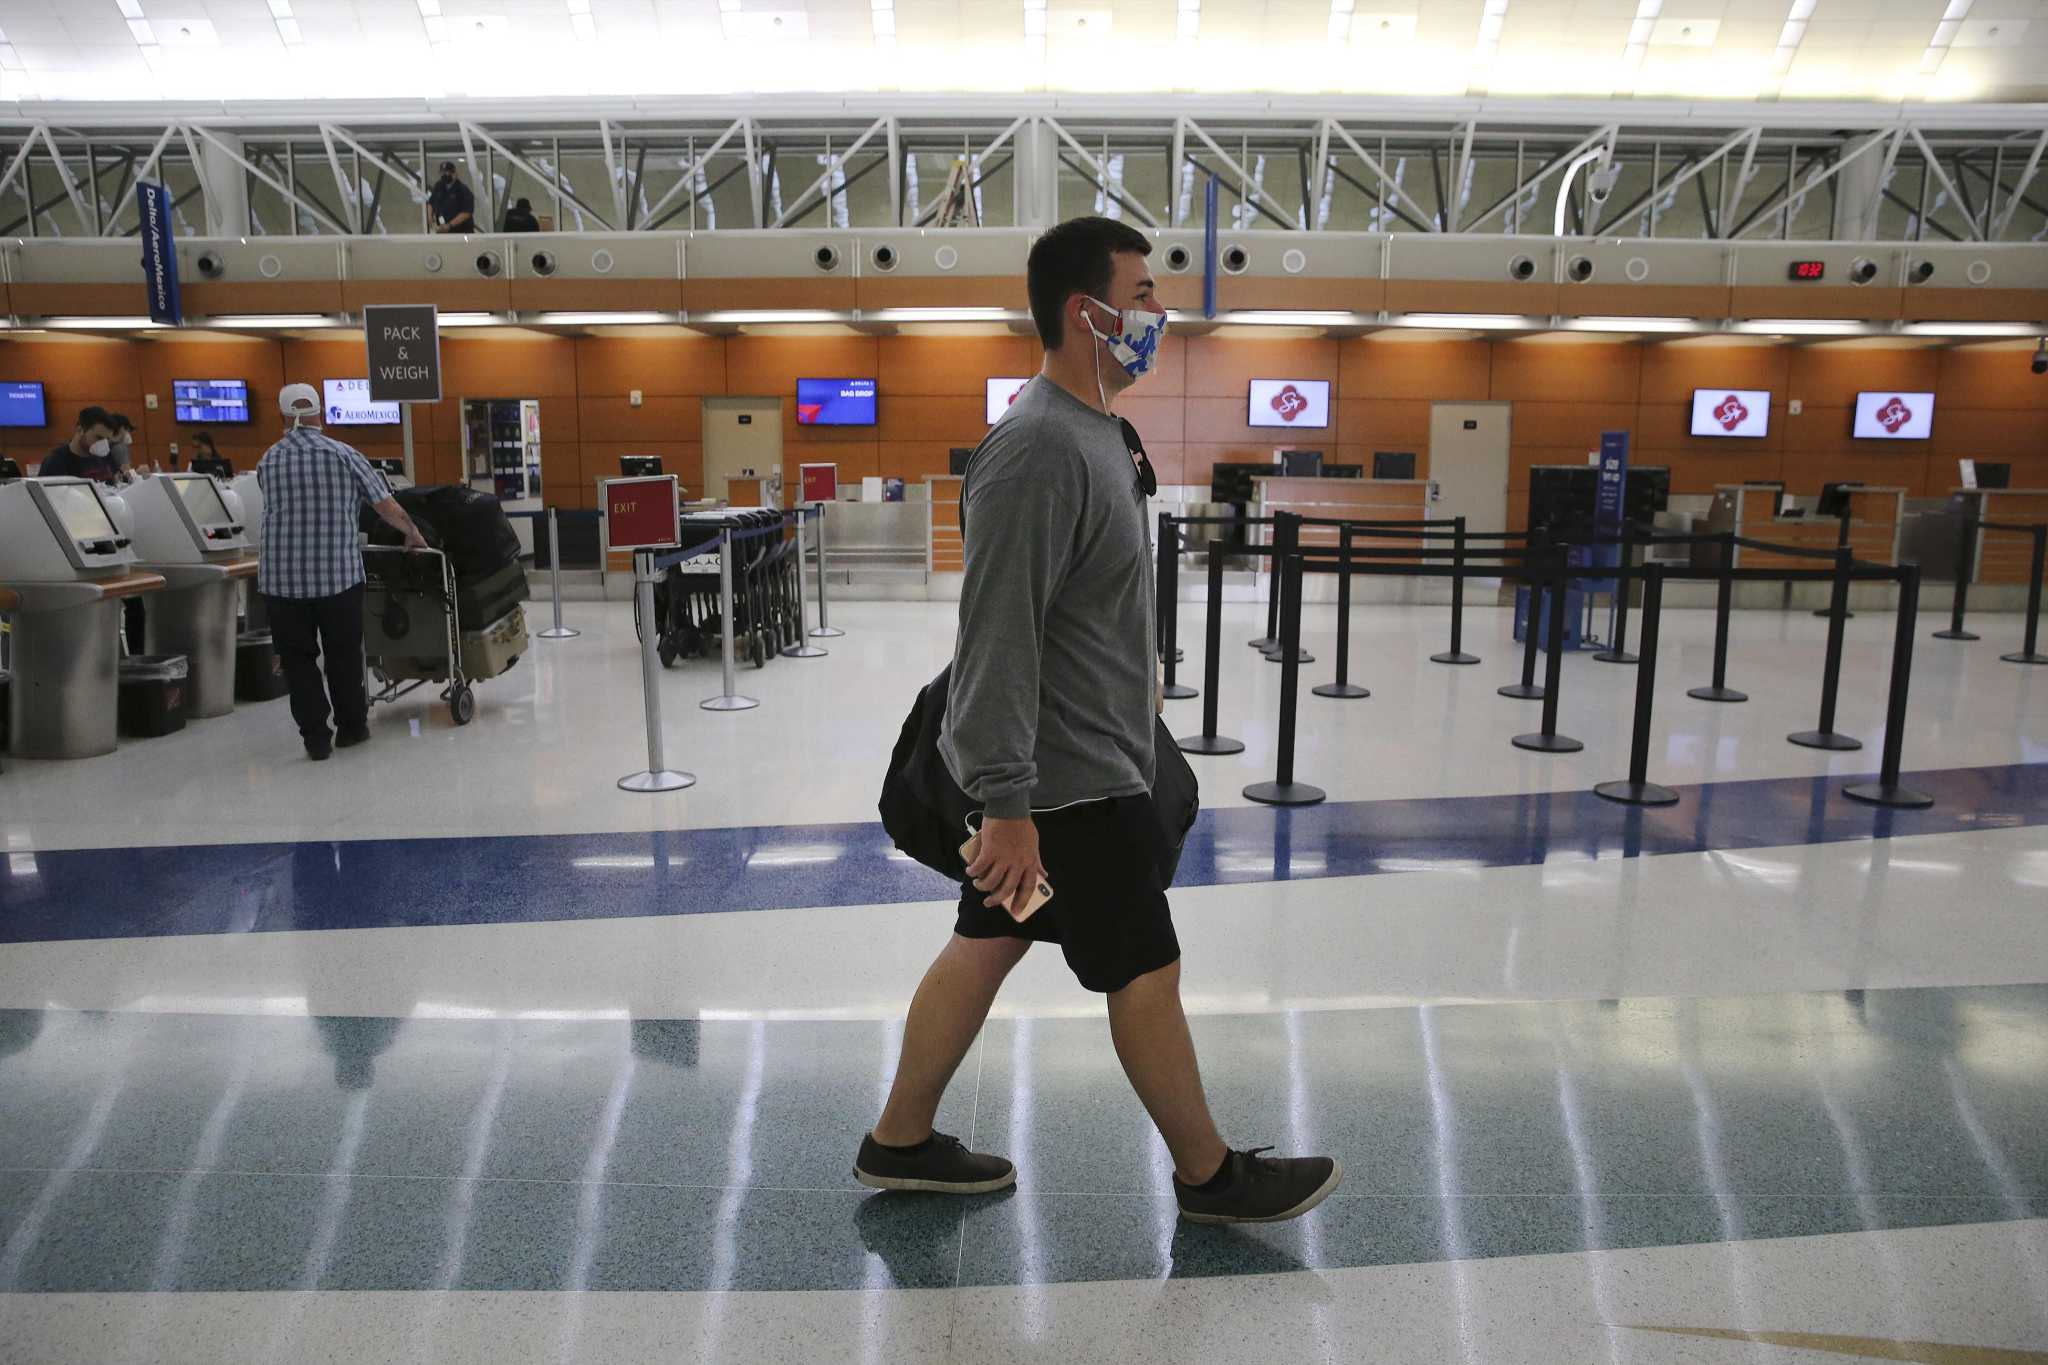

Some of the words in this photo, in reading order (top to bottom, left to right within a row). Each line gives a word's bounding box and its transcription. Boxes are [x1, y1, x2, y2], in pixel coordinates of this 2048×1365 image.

[146, 187, 166, 311] Delta/AeroMexico
[383, 326, 421, 341] PACK
[398, 346, 409, 360] &
[380, 366, 429, 380] WEIGH
[840, 389, 855, 398] BAG
[855, 389, 874, 398] DROP
[614, 502, 637, 513] EXIT
